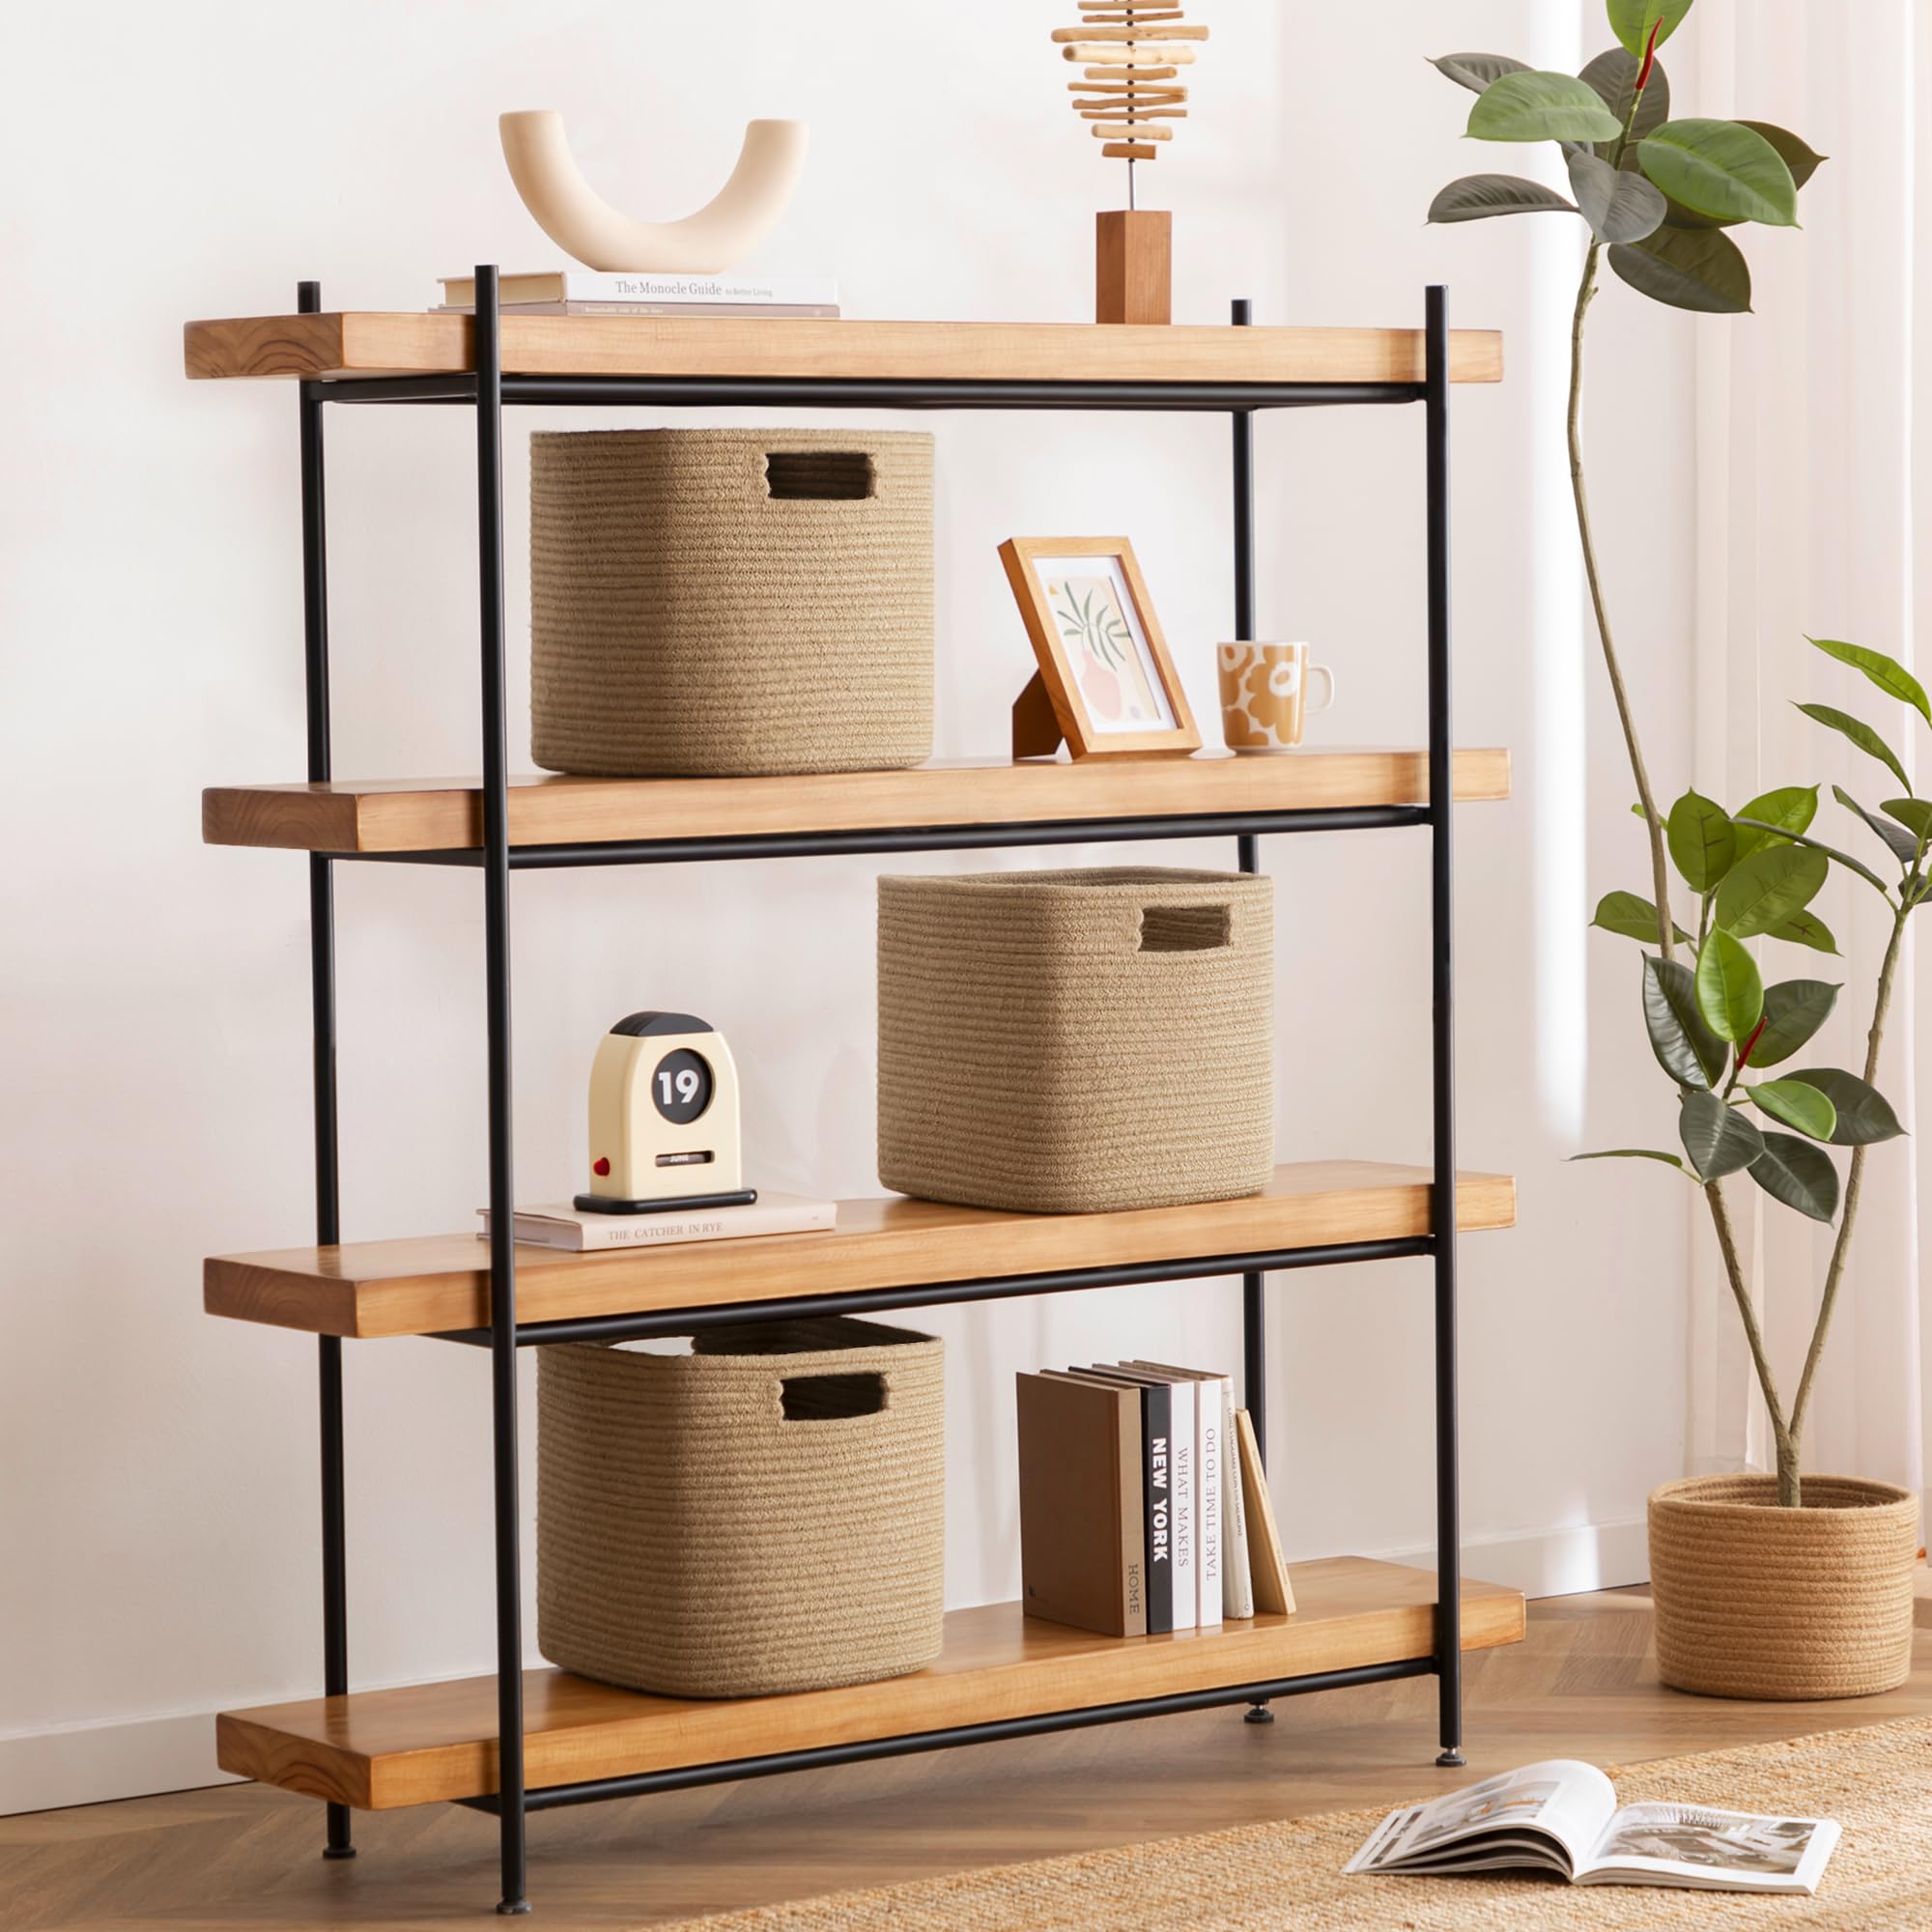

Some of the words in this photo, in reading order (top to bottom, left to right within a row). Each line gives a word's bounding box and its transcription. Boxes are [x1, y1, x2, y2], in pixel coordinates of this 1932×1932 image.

[615, 280, 637, 294] The
[639, 282, 687, 295] Monocle
[689, 282, 722, 296] Guide
[659, 1068, 699, 1105] 19
[610, 1231, 629, 1241] THE
[634, 1226, 684, 1238] CATCHER
[689, 1223, 700, 1234] IN
[702, 1222, 724, 1233] RYE
[1152, 1437, 1168, 1490] NEW
[1206, 1428, 1216, 1453] DO
[1178, 1447, 1188, 1499] WHAT
[1206, 1459, 1216, 1483] TO
[1153, 1498, 1168, 1563] YORK
[1206, 1486, 1217, 1531] TIME
[1178, 1507, 1189, 1567] MAKES
[1206, 1534, 1217, 1581] TAKE
[1128, 1564, 1140, 1615] HOME
